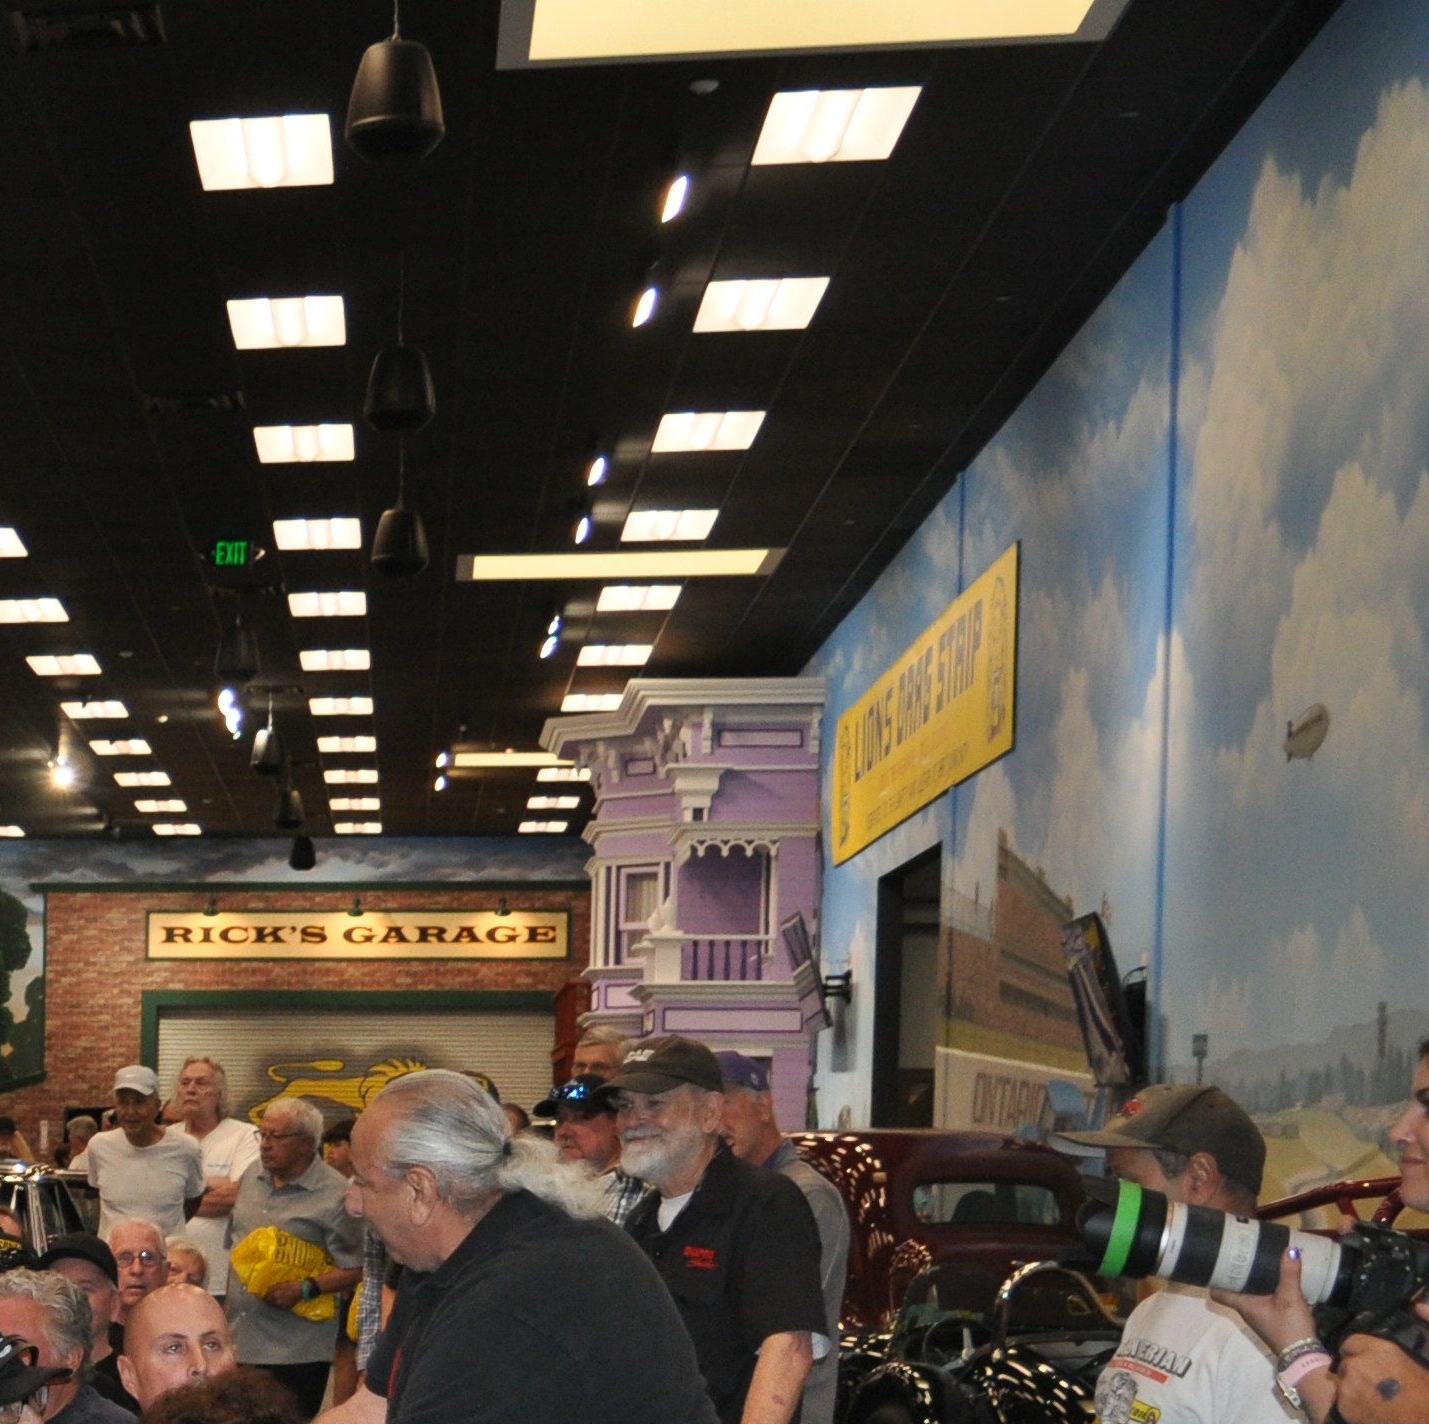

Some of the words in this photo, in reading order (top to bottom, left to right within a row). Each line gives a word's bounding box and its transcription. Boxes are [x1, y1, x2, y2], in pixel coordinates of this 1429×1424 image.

[215, 540, 248, 567] EXIT
[854, 686, 894, 784] LIONS
[896, 644, 935, 748] DRAG
[936, 597, 984, 715] STRIP
[160, 925, 328, 945] RICK'S
[342, 924, 559, 944] GARAGE
